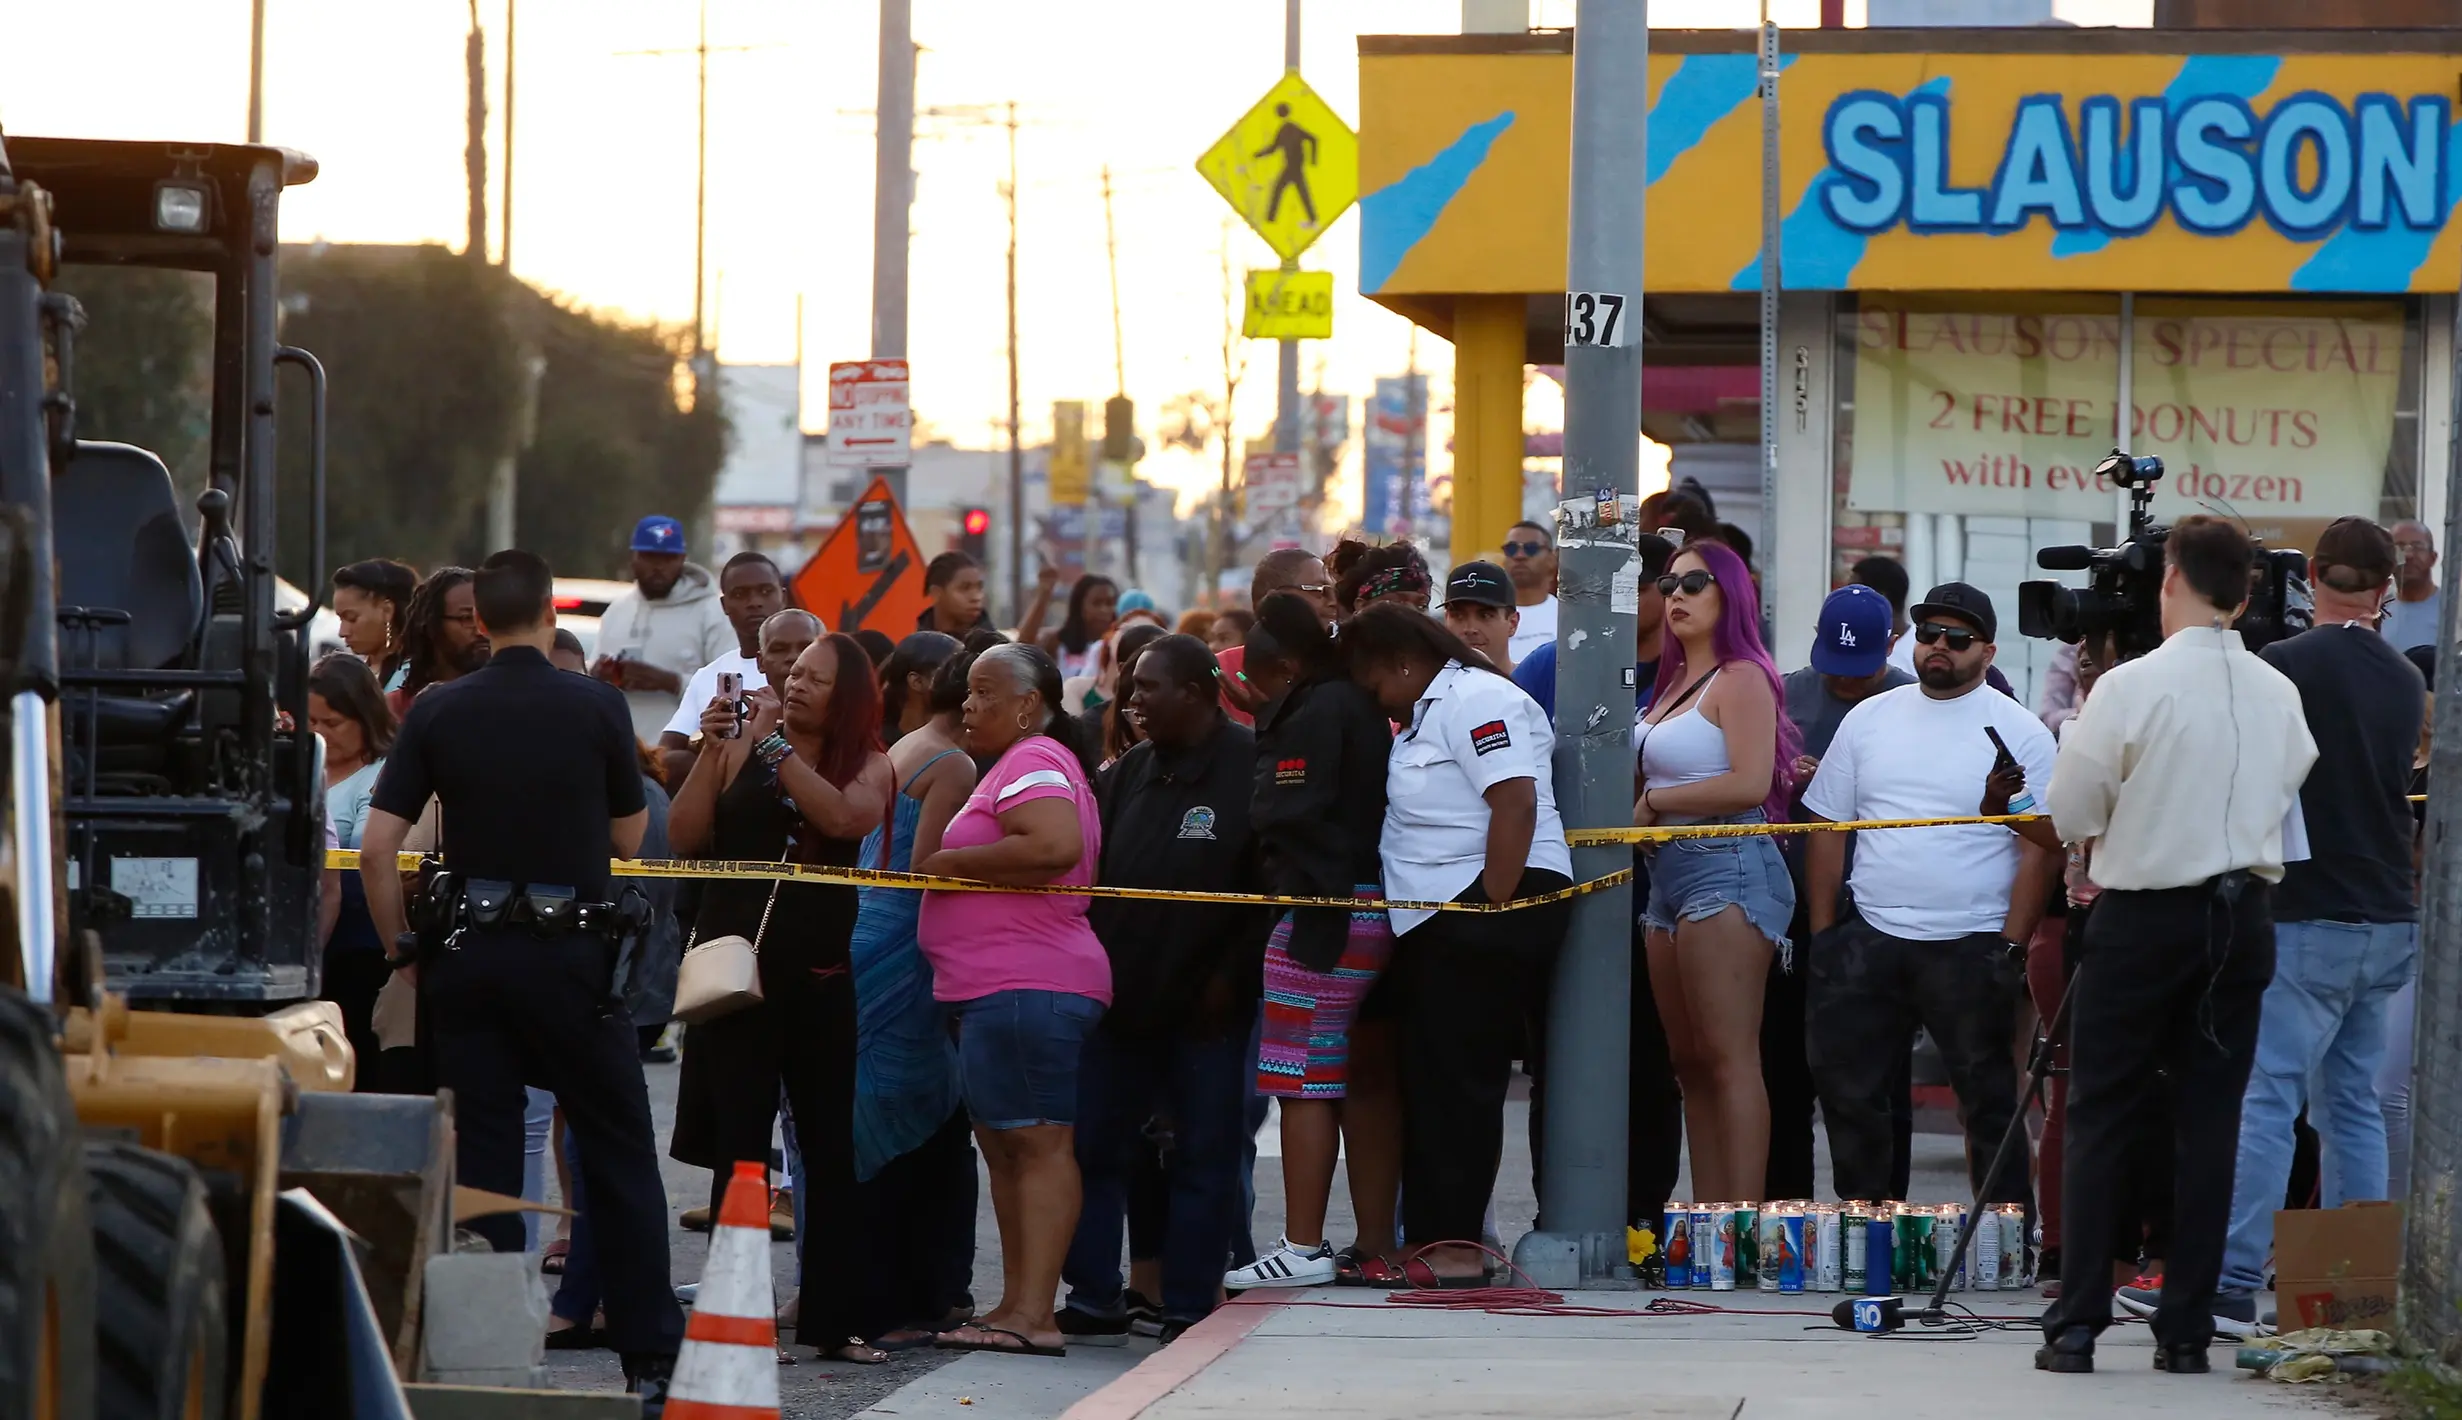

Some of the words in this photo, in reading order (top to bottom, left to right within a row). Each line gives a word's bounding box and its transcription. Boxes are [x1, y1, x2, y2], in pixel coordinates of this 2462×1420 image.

[1822, 91, 2449, 240] SLAUSON
[1253, 291, 1331, 316] AHEAD
[1859, 304, 2119, 362] SLAUSON
[2152, 318, 2397, 374] SPECIAL
[833, 413, 864, 429] ANY
[872, 411, 906, 428] TIME
[1929, 390, 1957, 430] 2
[1972, 391, 2093, 439] FREE
[2111, 402, 2319, 450] DONUTS
[1940, 456, 2030, 489] with
[2046, 464, 2159, 493] eve
[2176, 463, 2303, 502] dozen
[1839, 622, 1856, 647] LA
[1475, 731, 1507, 747] SECURITAS
[1860, 1304, 1882, 1328] 5
